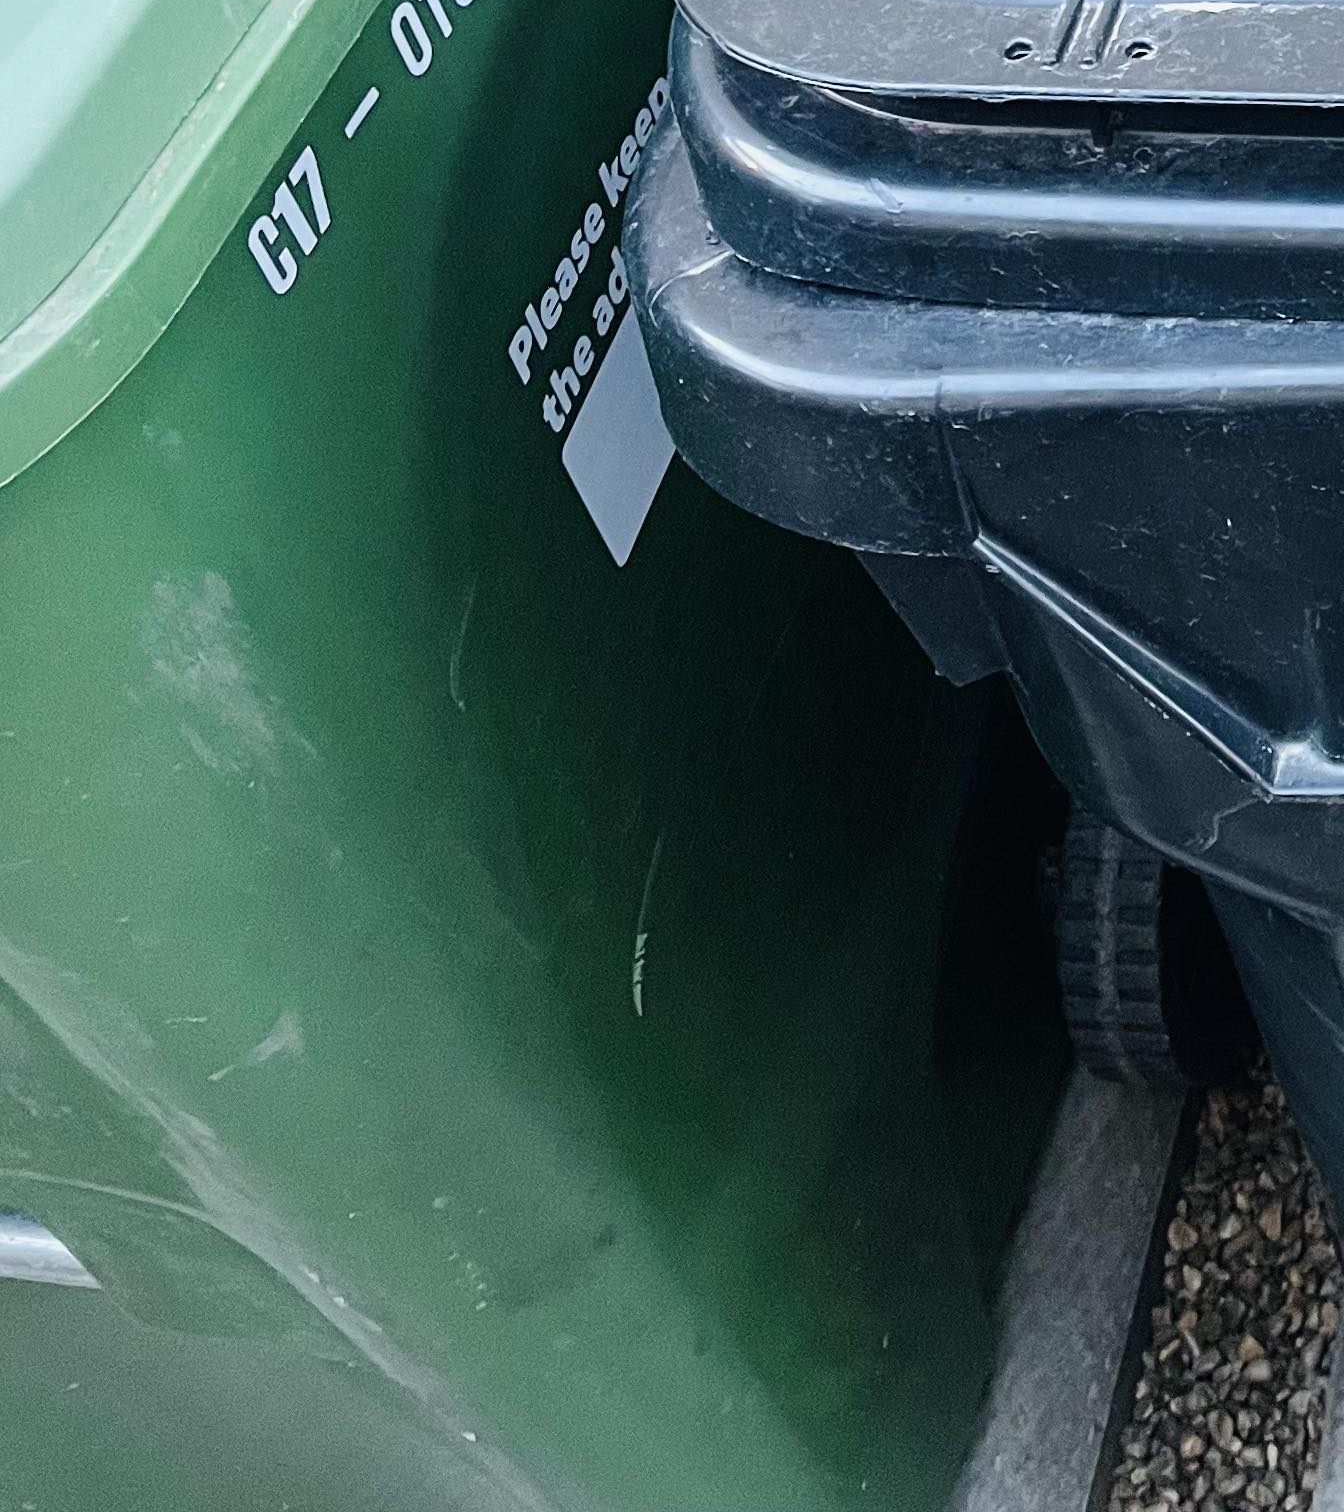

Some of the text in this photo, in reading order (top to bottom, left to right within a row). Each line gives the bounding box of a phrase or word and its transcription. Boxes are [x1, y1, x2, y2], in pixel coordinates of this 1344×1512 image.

[247, 144, 332, 296] C17
[507, 201, 606, 386] Please
[542, 334, 596, 433] the
